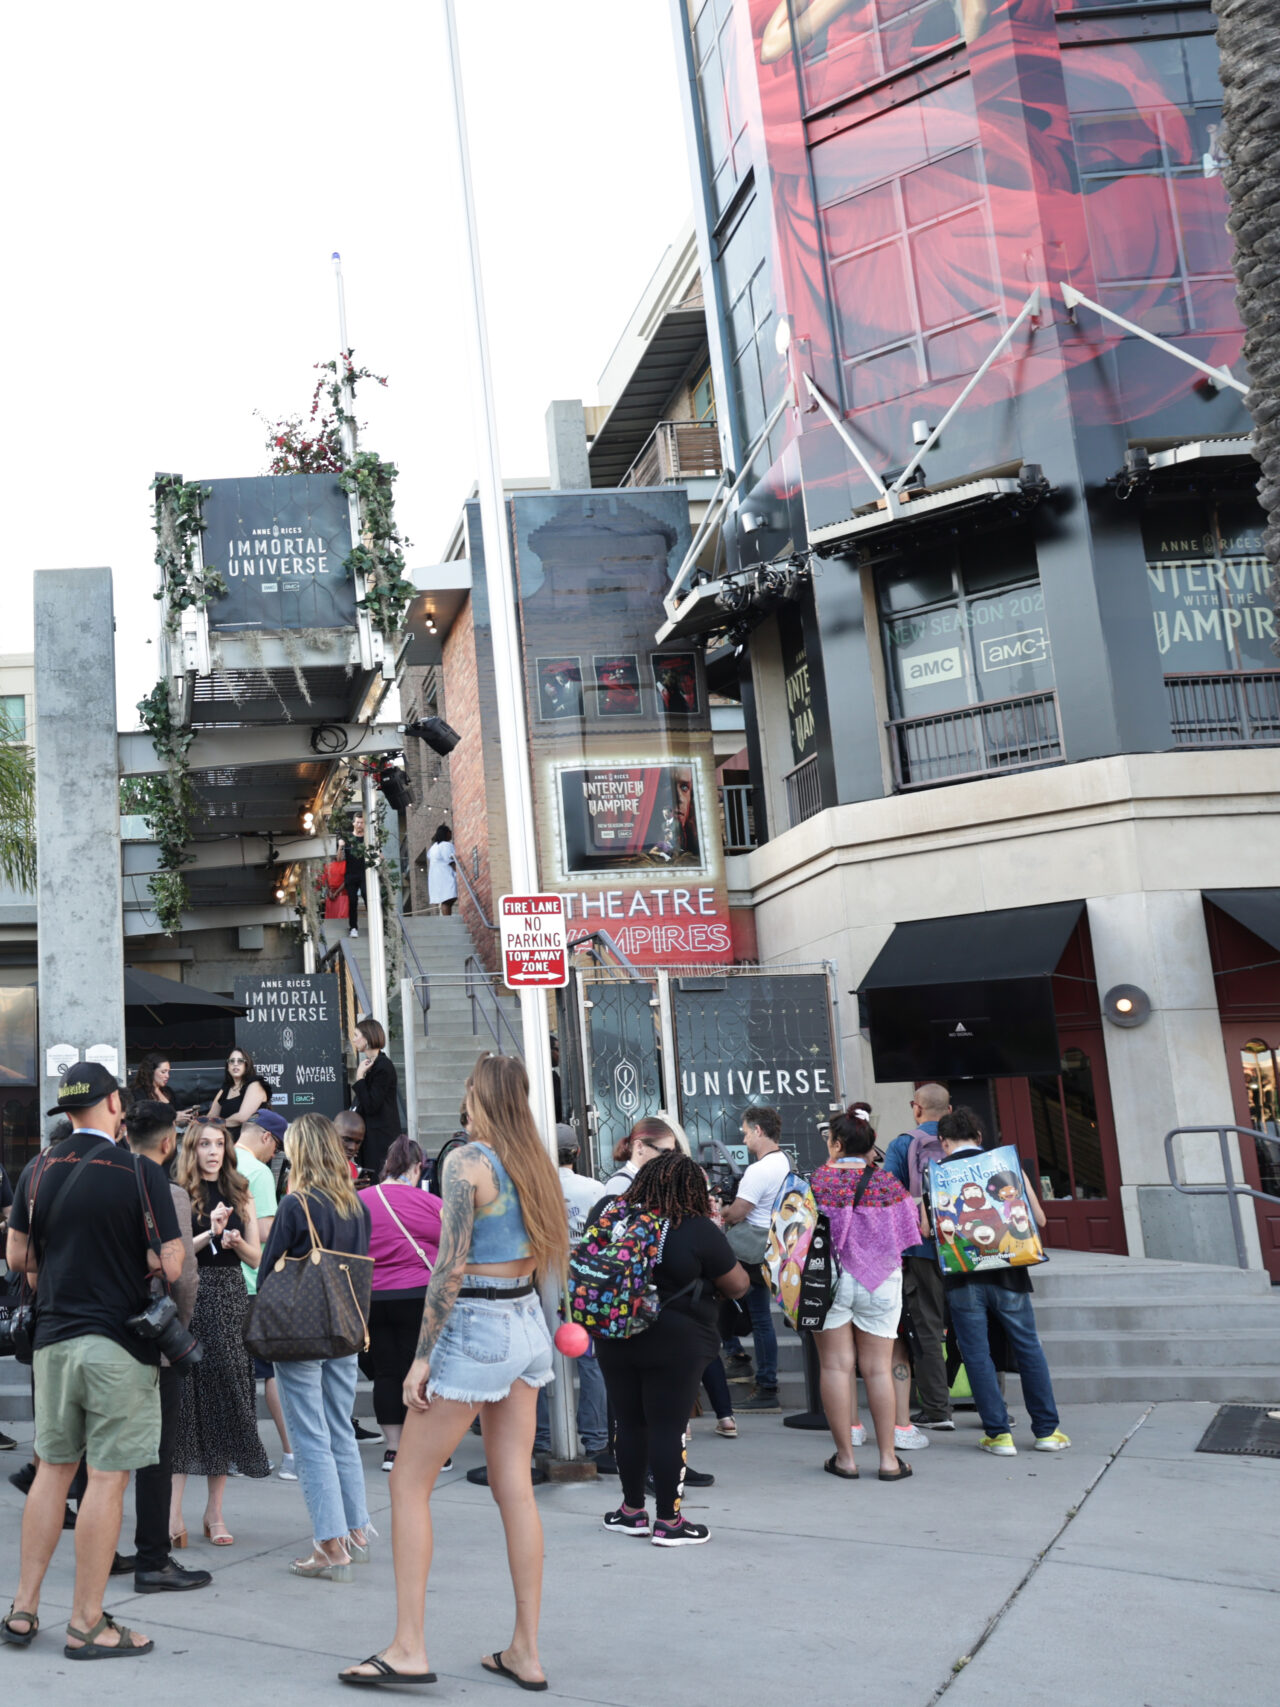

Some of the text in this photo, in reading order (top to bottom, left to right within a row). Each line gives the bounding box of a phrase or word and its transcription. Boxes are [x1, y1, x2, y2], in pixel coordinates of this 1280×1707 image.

[229, 538, 326, 557] IMMORTAL
[1161, 540, 1199, 552] ANNE
[229, 557, 329, 577] UNIVERSE
[1184, 592, 1255, 606] WITH THE
[887, 593, 1044, 646] NEW SEASON 202
[1153, 607, 1279, 655] VAMPIR
[582, 781, 644, 798] INTERVIEW
[588, 799, 640, 816] VAMPIRE
[505, 901, 559, 913] FIRE LANE
[561, 888, 717, 919] THEATRE
[524, 917, 542, 931] NO
[507, 932, 561, 948] PARKING
[508, 951, 561, 962] TOW-AWAY
[522, 962, 550, 972] ZONE
[245, 990, 327, 1006] IMMORTAL
[246, 1007, 328, 1022] UNIVERSE
[296, 1065, 334, 1077] MAYFAIR
[296, 1074, 336, 1085] WITCHES
[682, 1068, 831, 1097] UNIVERSE
[936, 1164, 1008, 1189] Great North
